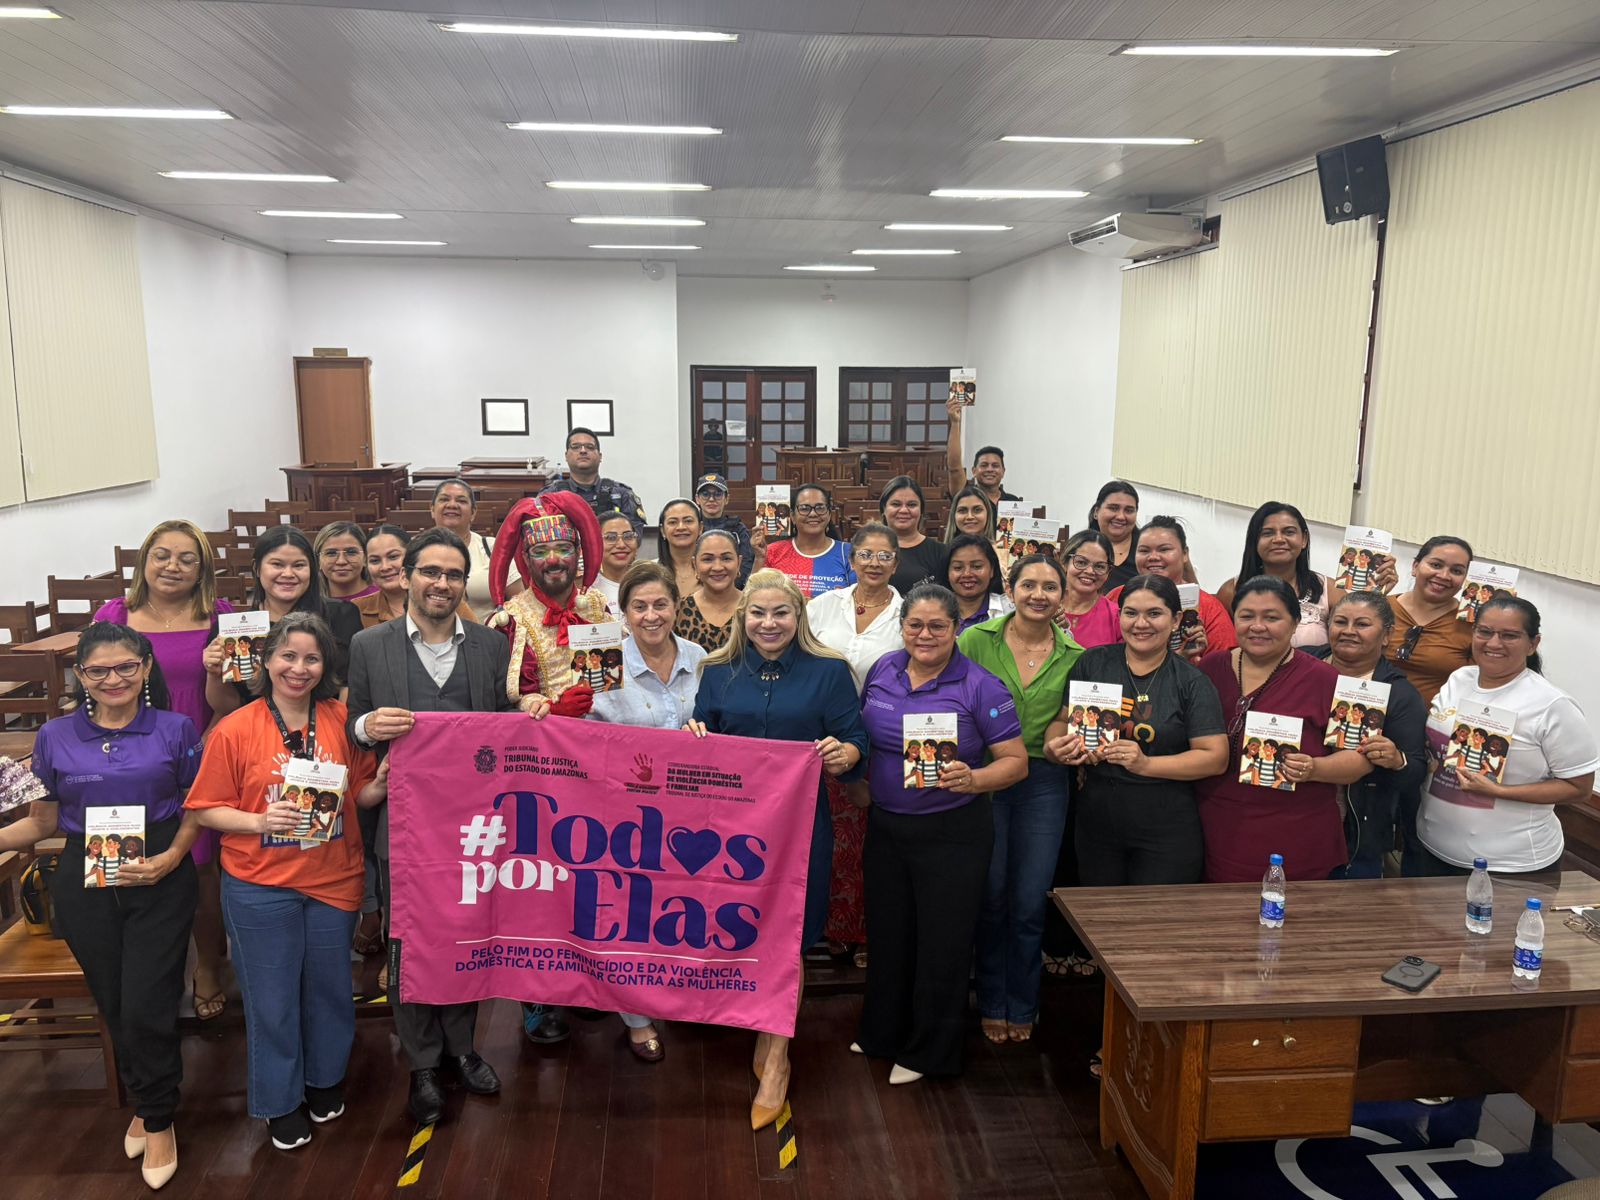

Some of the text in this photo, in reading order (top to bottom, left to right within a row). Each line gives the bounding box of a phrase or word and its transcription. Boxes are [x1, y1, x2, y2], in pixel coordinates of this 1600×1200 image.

[809, 575, 844, 583] PROTEÇÃO
[504, 754, 579, 769] TRIBUNAL DE JUSTIÇA
[504, 765, 588, 780] DO ESTADO DO AMAZONAS
[676, 769, 701, 777] MULHER
[712, 772, 742, 782] SITUAÇÃO
[670, 784, 699, 792] FAMILIAR
[675, 775, 707, 785] VIOLÊNCIA
[707, 779, 743, 789] DOMÉSTICA
[457, 857, 761, 952] por Elas
[471, 944, 743, 979] PELO FIM DO FEMINICÍDIO E DA VIOLÊNCIA
[455, 953, 757, 992] DOMÉSTICA E FAMILIAR CONTRA AS MULHERES
